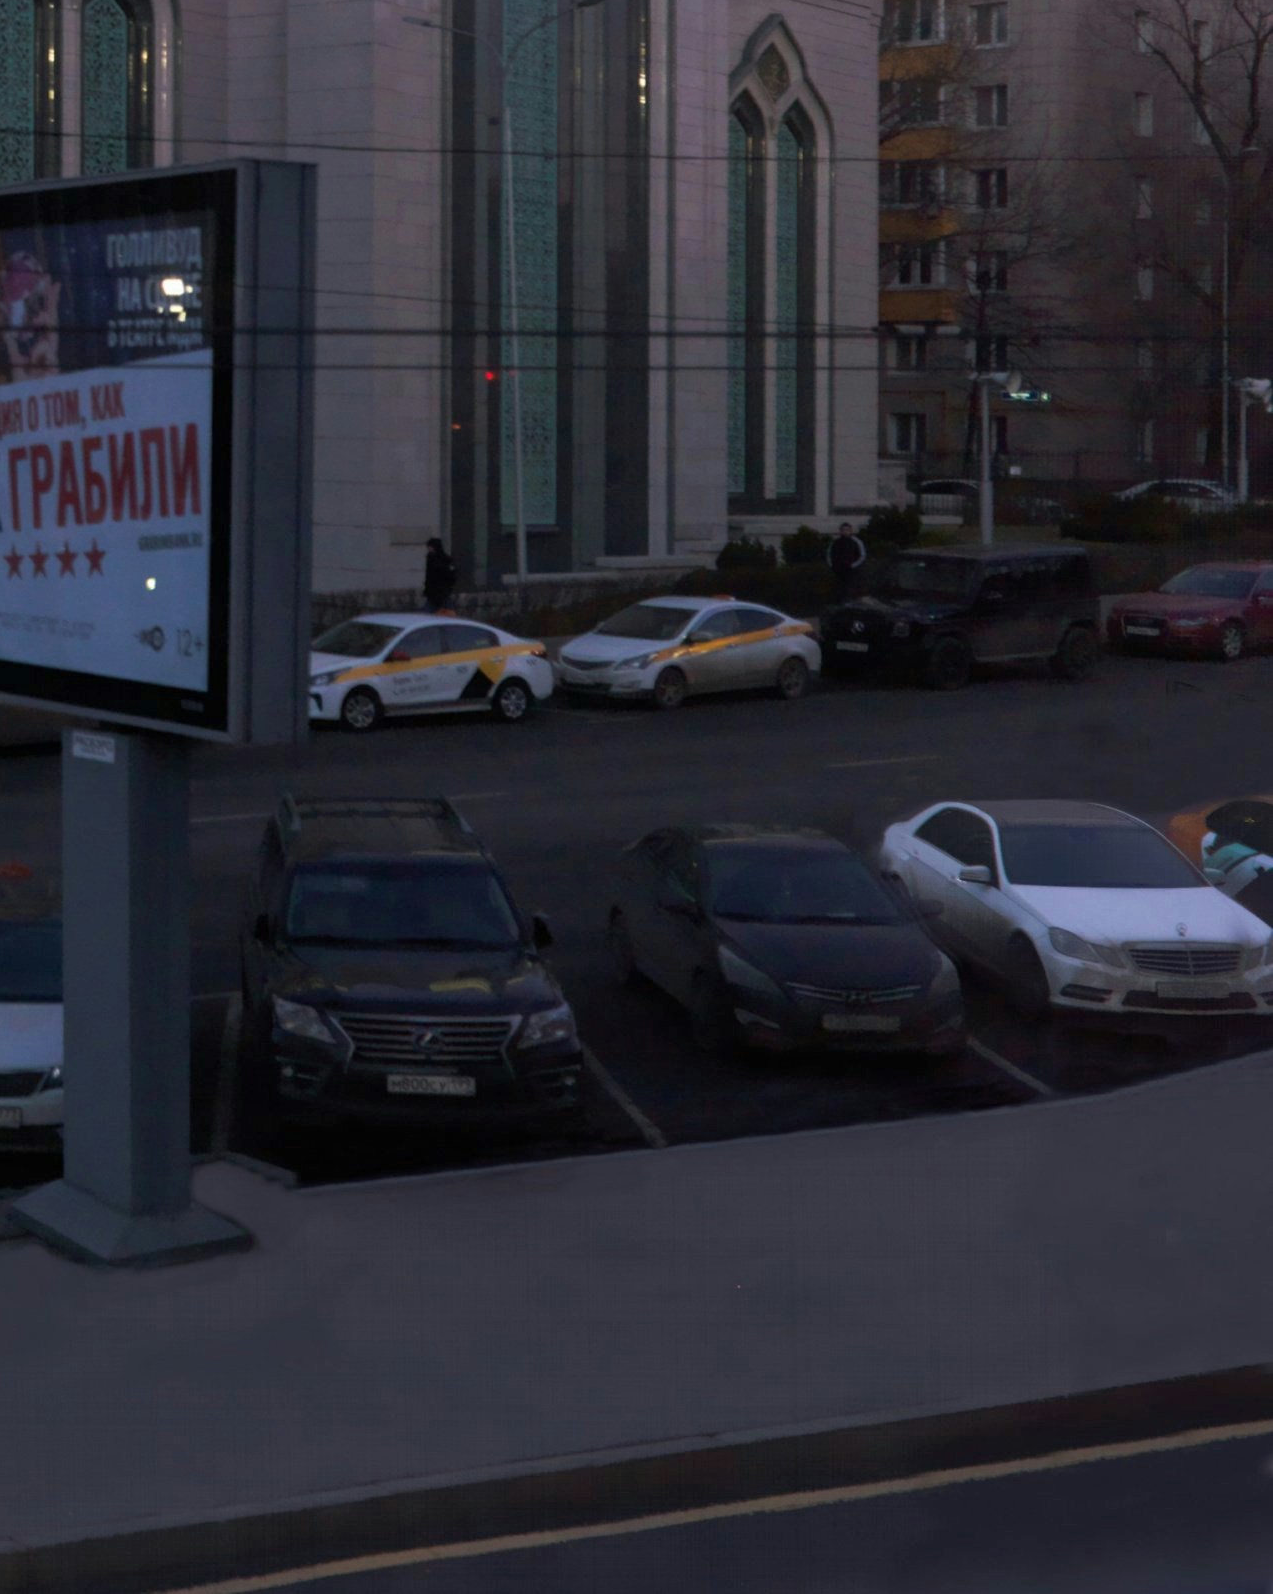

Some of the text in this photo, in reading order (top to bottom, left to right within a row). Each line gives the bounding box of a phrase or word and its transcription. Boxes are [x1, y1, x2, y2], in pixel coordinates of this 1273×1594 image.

[106, 226, 202, 270] ГОЛЛИВУД
[117, 277, 142, 312] НА
[28, 395, 39, 433] О
[43, 388, 87, 429] ТОМ,
[90, 381, 126, 421] КАК
[7, 422, 202, 532] ГРАБИЛИ
[176, 628, 205, 657] 12+
